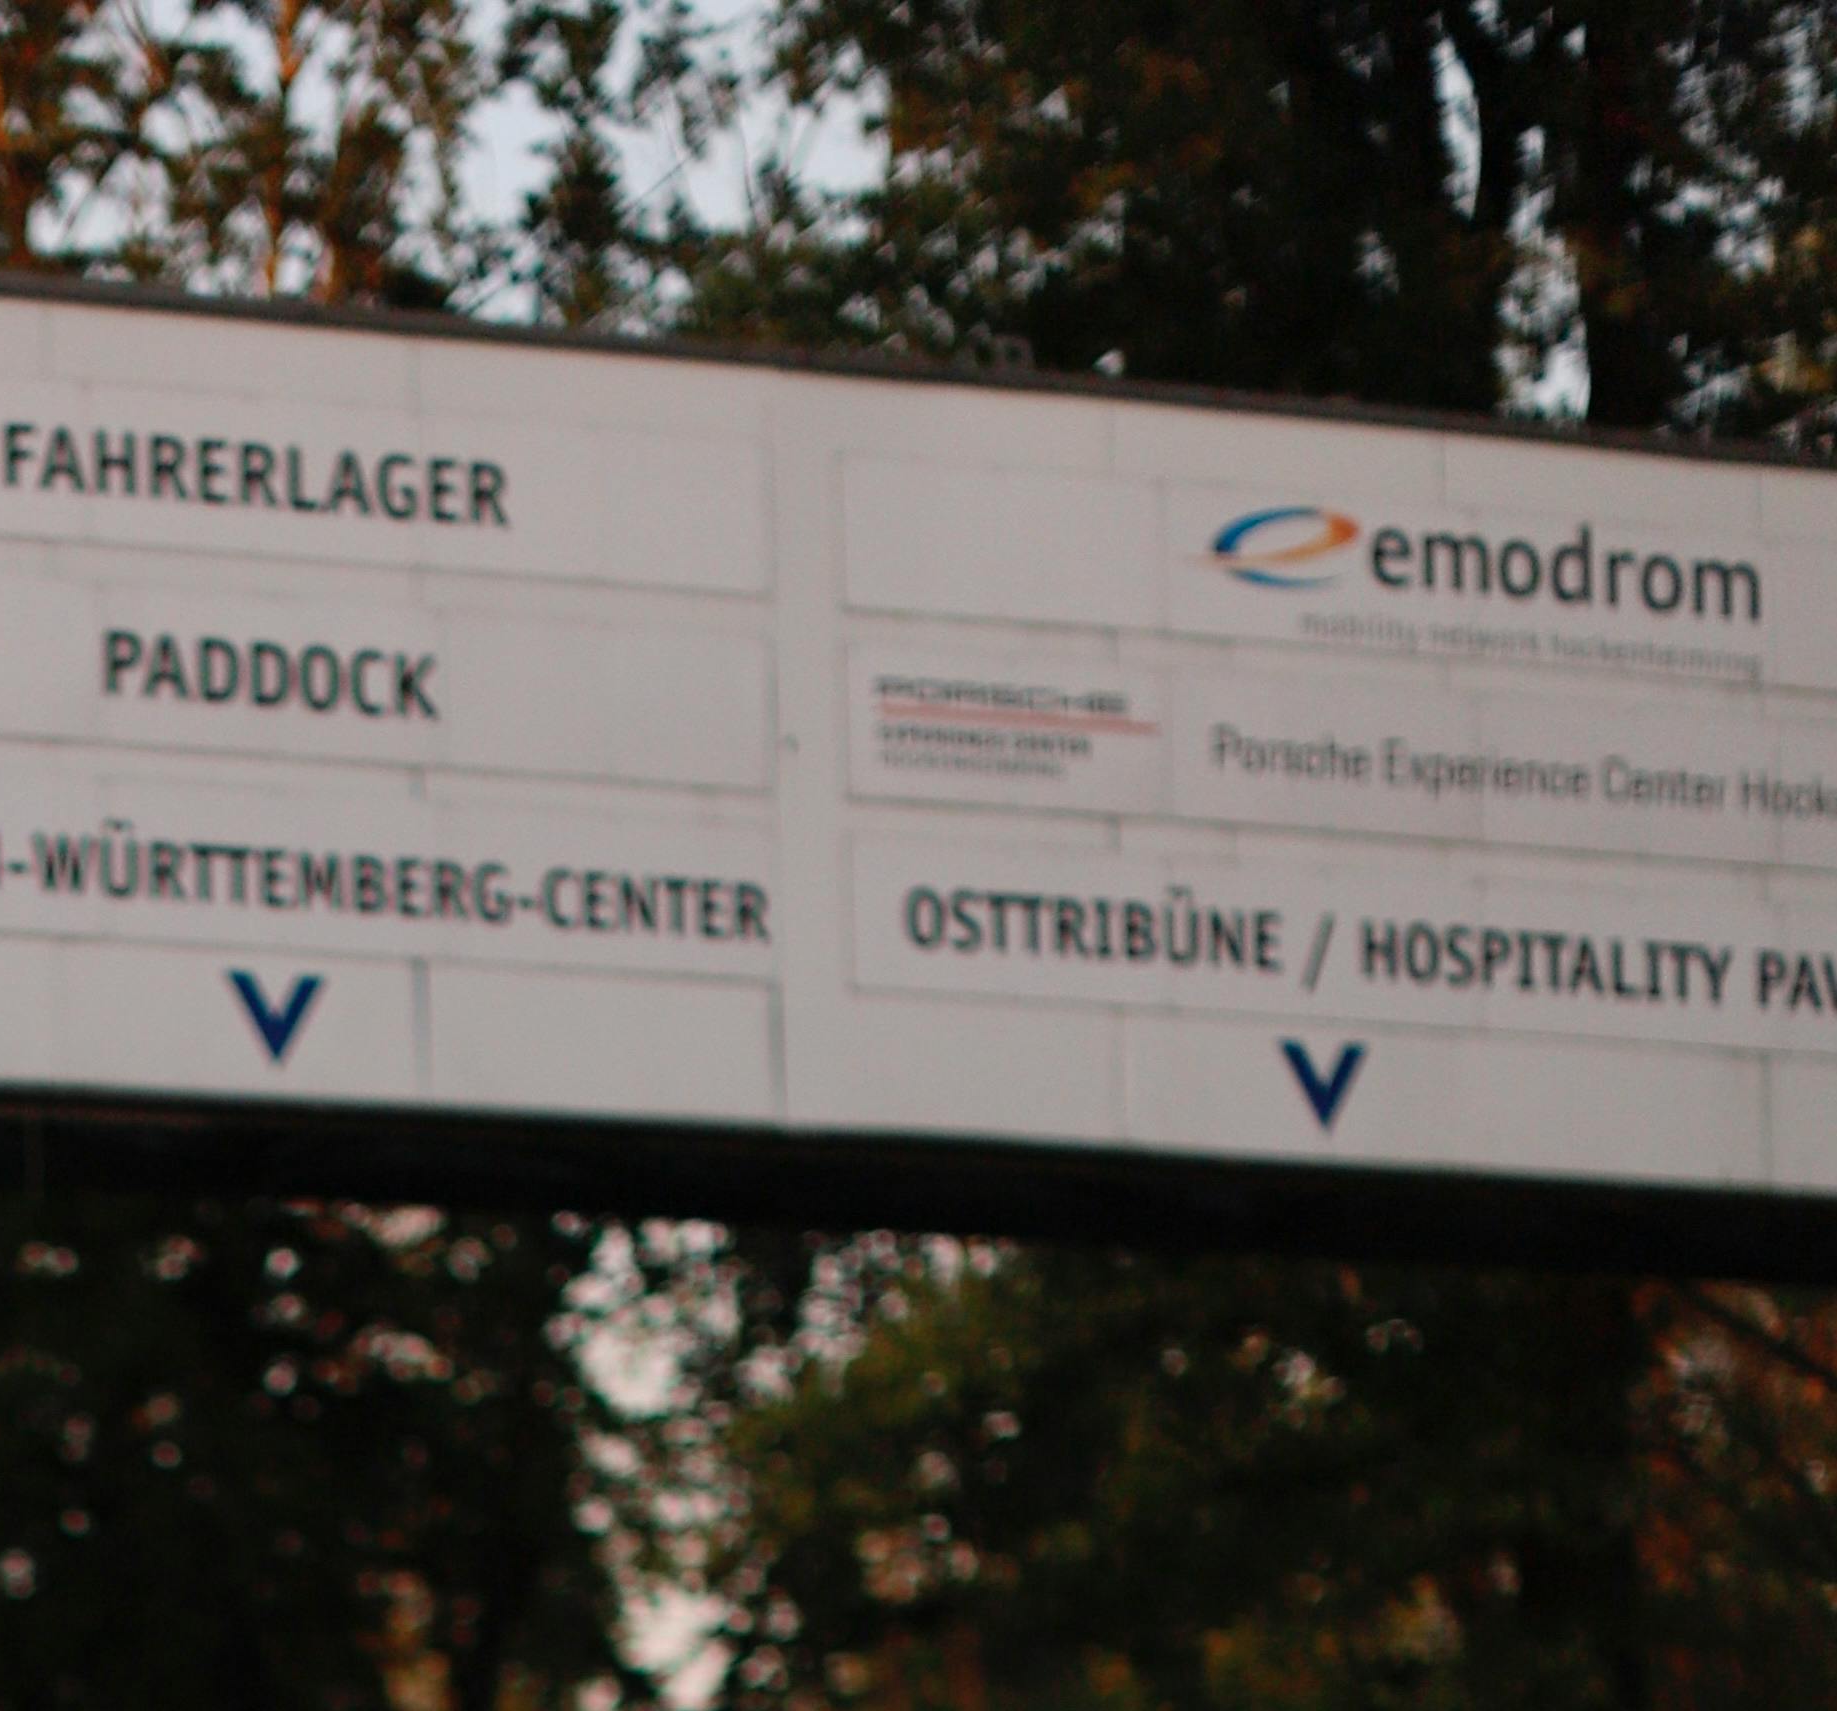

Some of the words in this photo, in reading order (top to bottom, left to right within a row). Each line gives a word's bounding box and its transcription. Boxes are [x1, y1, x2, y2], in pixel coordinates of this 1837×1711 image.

[1, 421, 511, 528] FAHRERLAGER
[1367, 522, 1763, 624] emodrom
[101, 628, 441, 722] PADDOCK
[1209, 723, 1369, 782] Porsche
[1380, 738, 1590, 800] Experience
[1601, 755, 1725, 808] Center
[904, 886, 1283, 974] OSTTRIBÜNE
[1359, 920, 1734, 1006] HOSPITALITY
